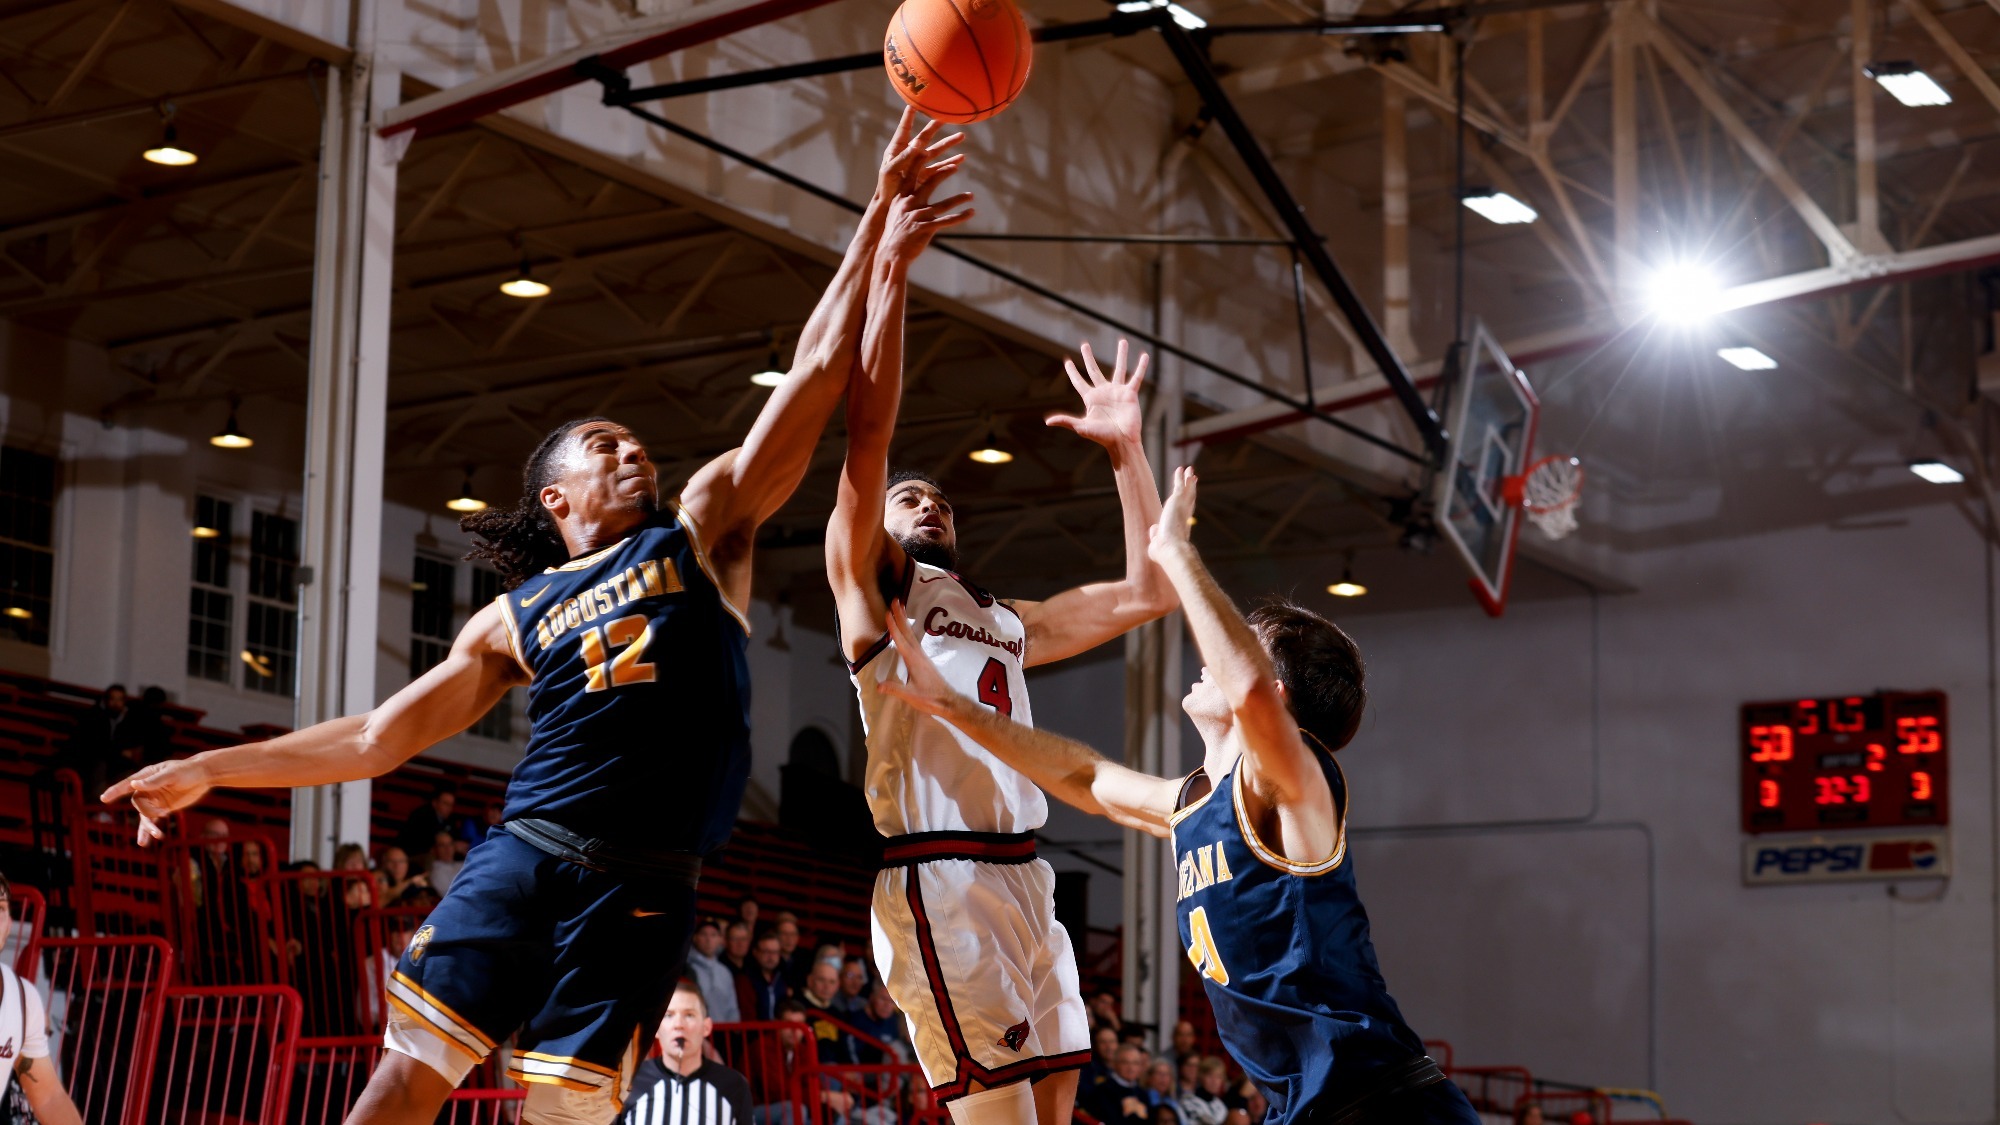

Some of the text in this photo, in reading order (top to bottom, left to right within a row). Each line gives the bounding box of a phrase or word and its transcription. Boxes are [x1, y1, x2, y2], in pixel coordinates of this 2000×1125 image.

[537, 557, 685, 650] AUGUSTANA
[580, 614, 657, 693] 12
[977, 656, 1012, 720] 4
[1866, 743, 1886, 771] 2
[1897, 716, 1941, 754] 55
[1754, 845, 1865, 876] PEPSI
